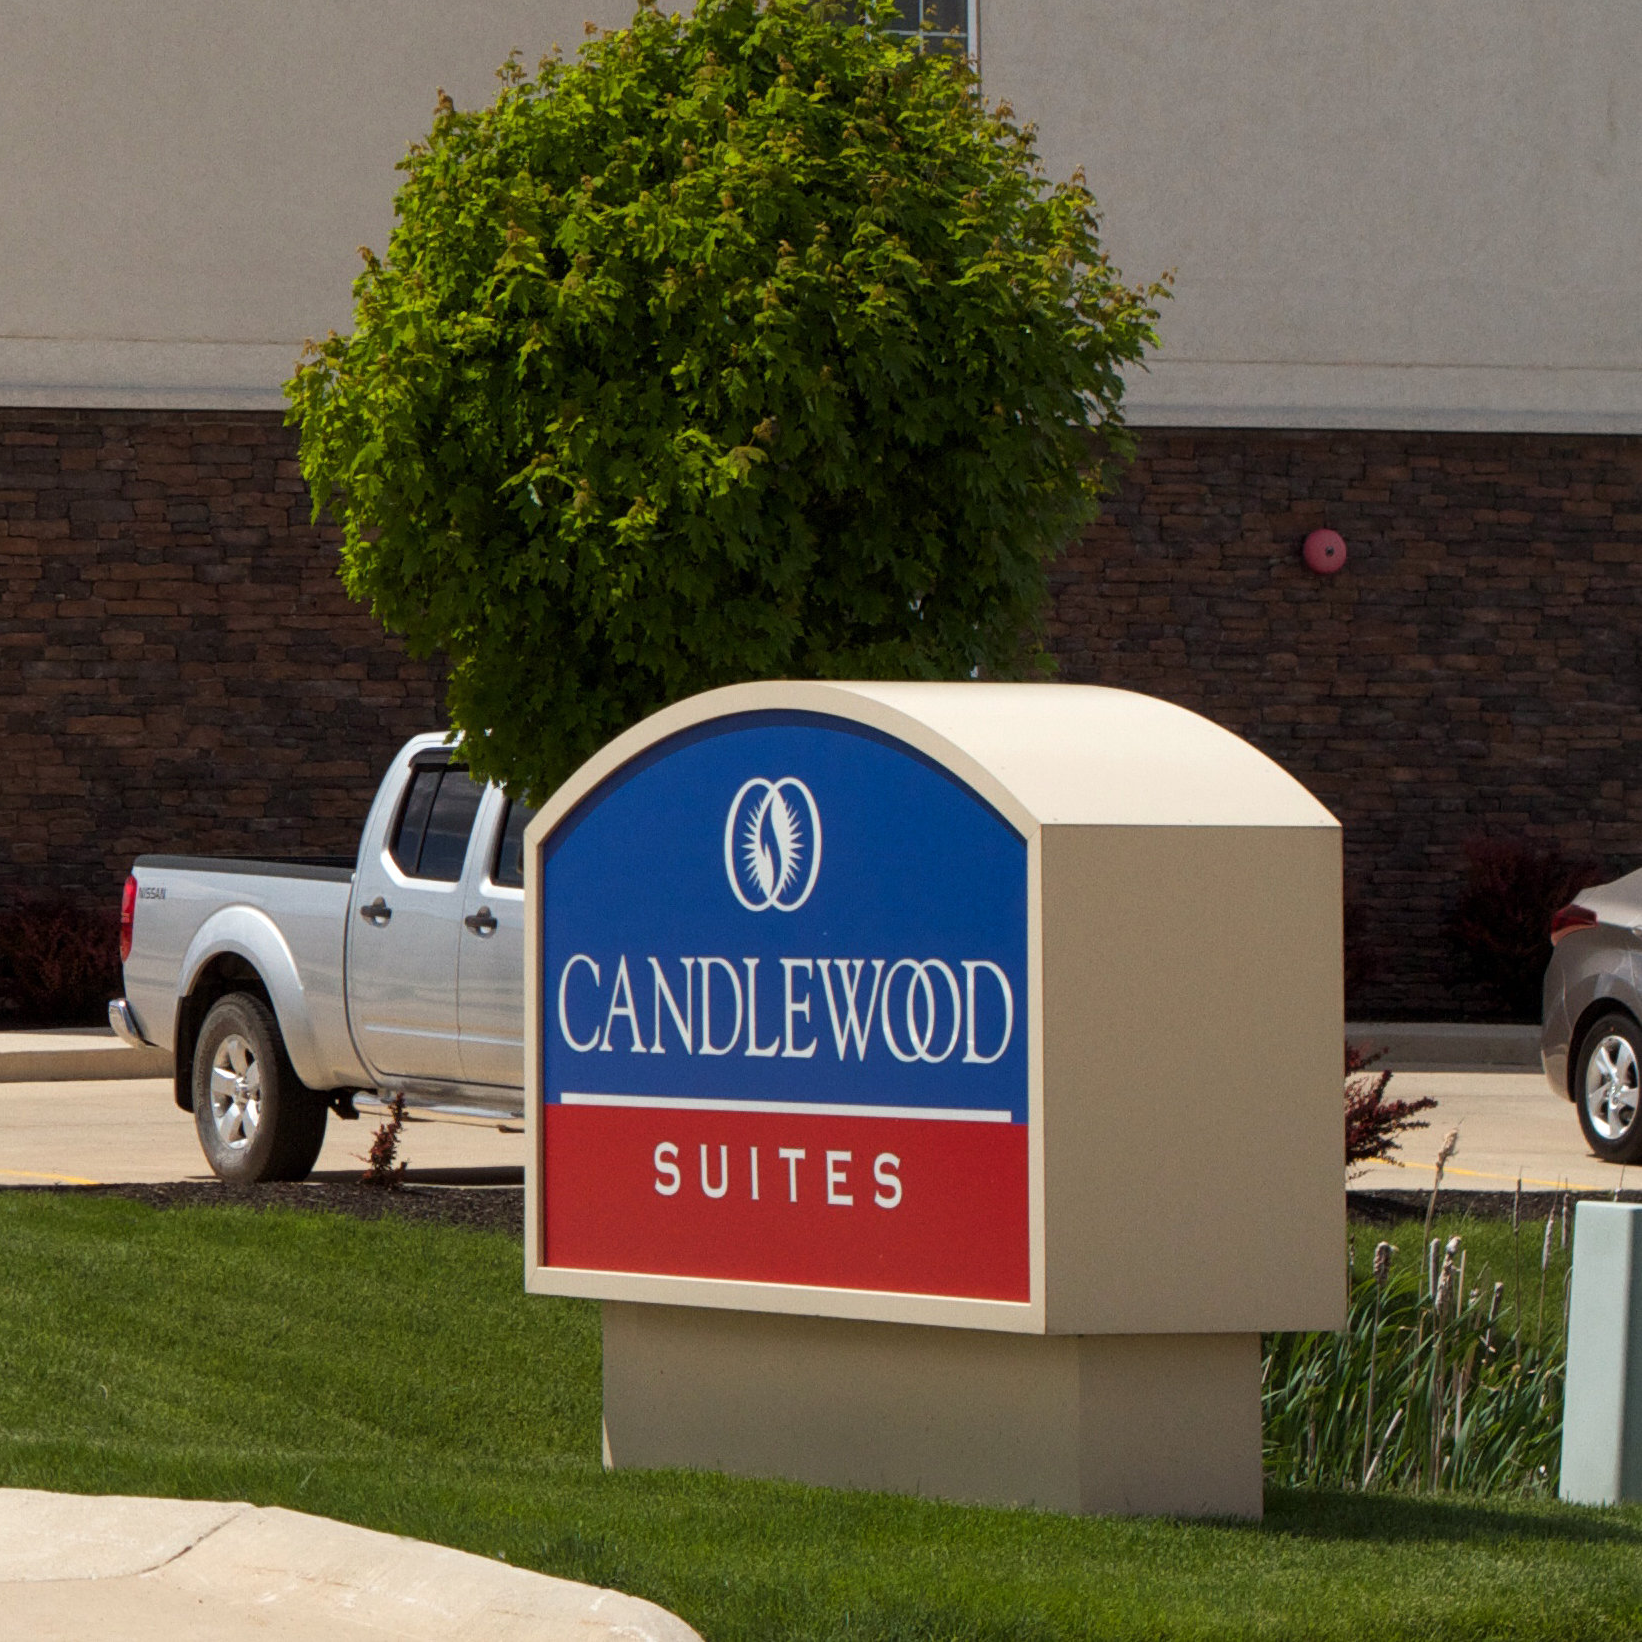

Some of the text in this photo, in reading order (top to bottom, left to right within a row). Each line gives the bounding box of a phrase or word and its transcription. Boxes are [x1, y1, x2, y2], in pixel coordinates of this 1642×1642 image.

[138, 886, 166, 900] NISSAN
[557, 953, 1014, 1064] CANDLEWOOD
[653, 1141, 903, 1209] SUITES
